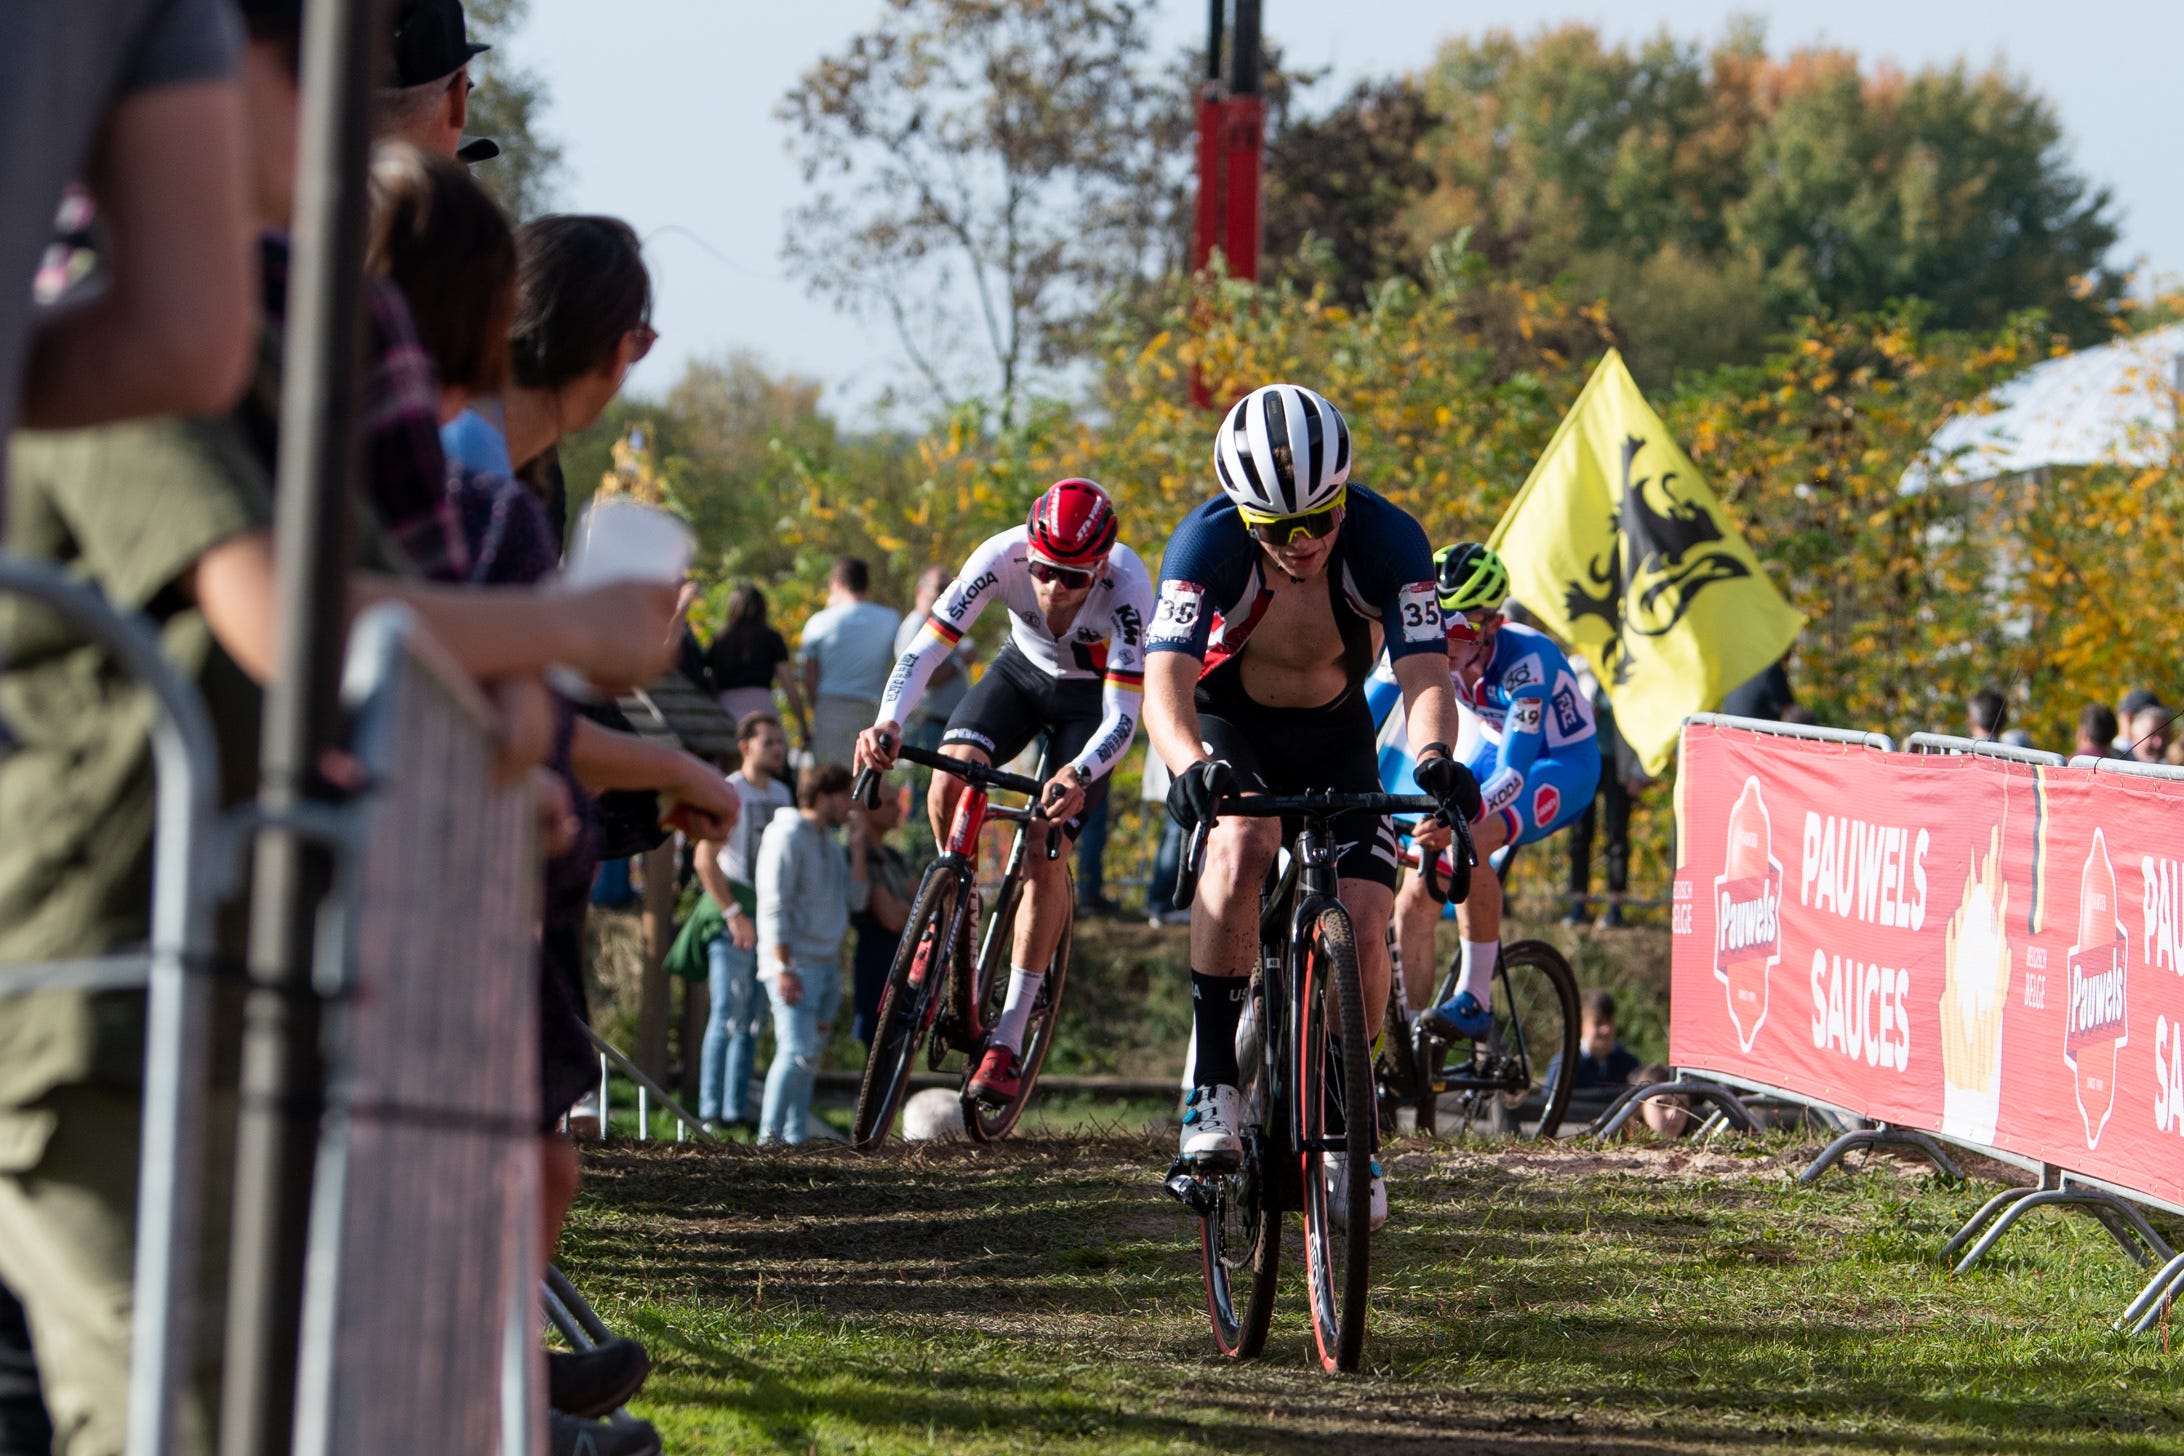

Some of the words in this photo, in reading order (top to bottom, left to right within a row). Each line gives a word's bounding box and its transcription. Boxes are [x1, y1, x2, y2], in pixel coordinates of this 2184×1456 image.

[946, 571, 999, 621] ŠKODA
[1160, 599, 1196, 624] 35
[1404, 601, 1439, 627] 35
[1115, 603, 1142, 646] KTM
[1514, 709, 1538, 725] 49
[1801, 811, 1929, 931] PAUWELS
[1672, 903, 1692, 934] ELGE
[1720, 878, 1776, 952] Pauwels
[1811, 948, 1910, 1072] SAUCES
[2024, 972, 2046, 1010] BELGE
[2071, 946, 2124, 1035] Pauwels
